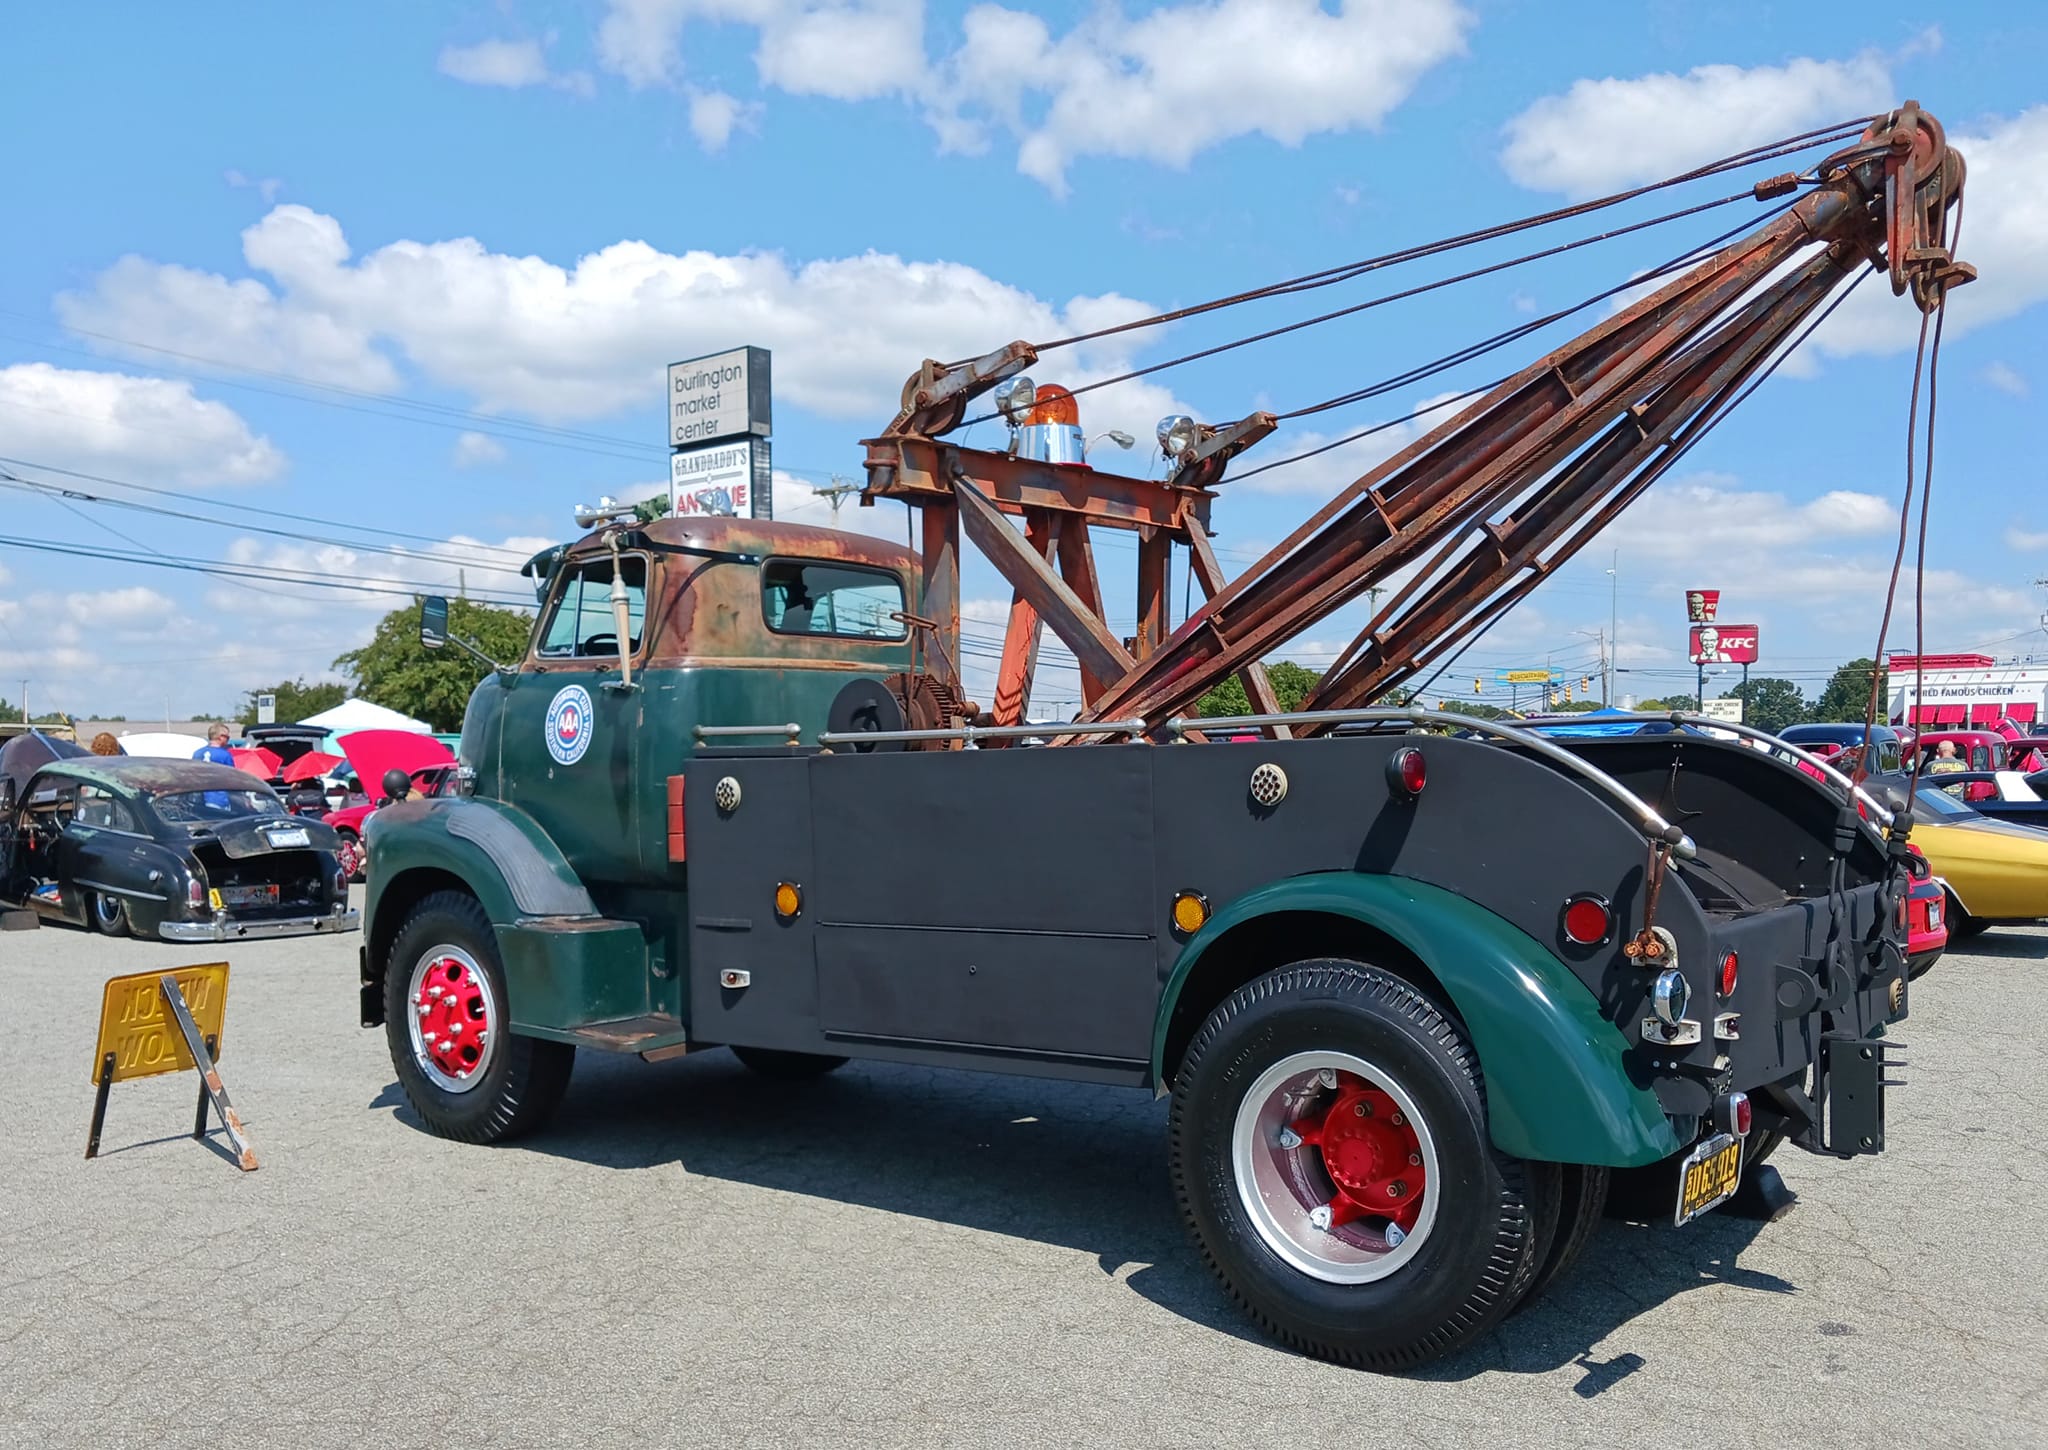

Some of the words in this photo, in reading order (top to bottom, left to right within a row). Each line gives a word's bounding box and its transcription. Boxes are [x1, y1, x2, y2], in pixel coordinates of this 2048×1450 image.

[675, 365, 742, 393] burlington
[675, 391, 721, 416] market
[676, 418, 719, 440] center
[675, 448, 747, 476] GRANDDADDY'S
[677, 485, 747, 514] ANUE
[1720, 637, 1755, 648] KFC
[1909, 688, 1938, 697] WRLD
[1941, 687, 1975, 697] FAMOUS
[1977, 687, 2014, 696] CHICKEN
[558, 711, 579, 733] AAA
